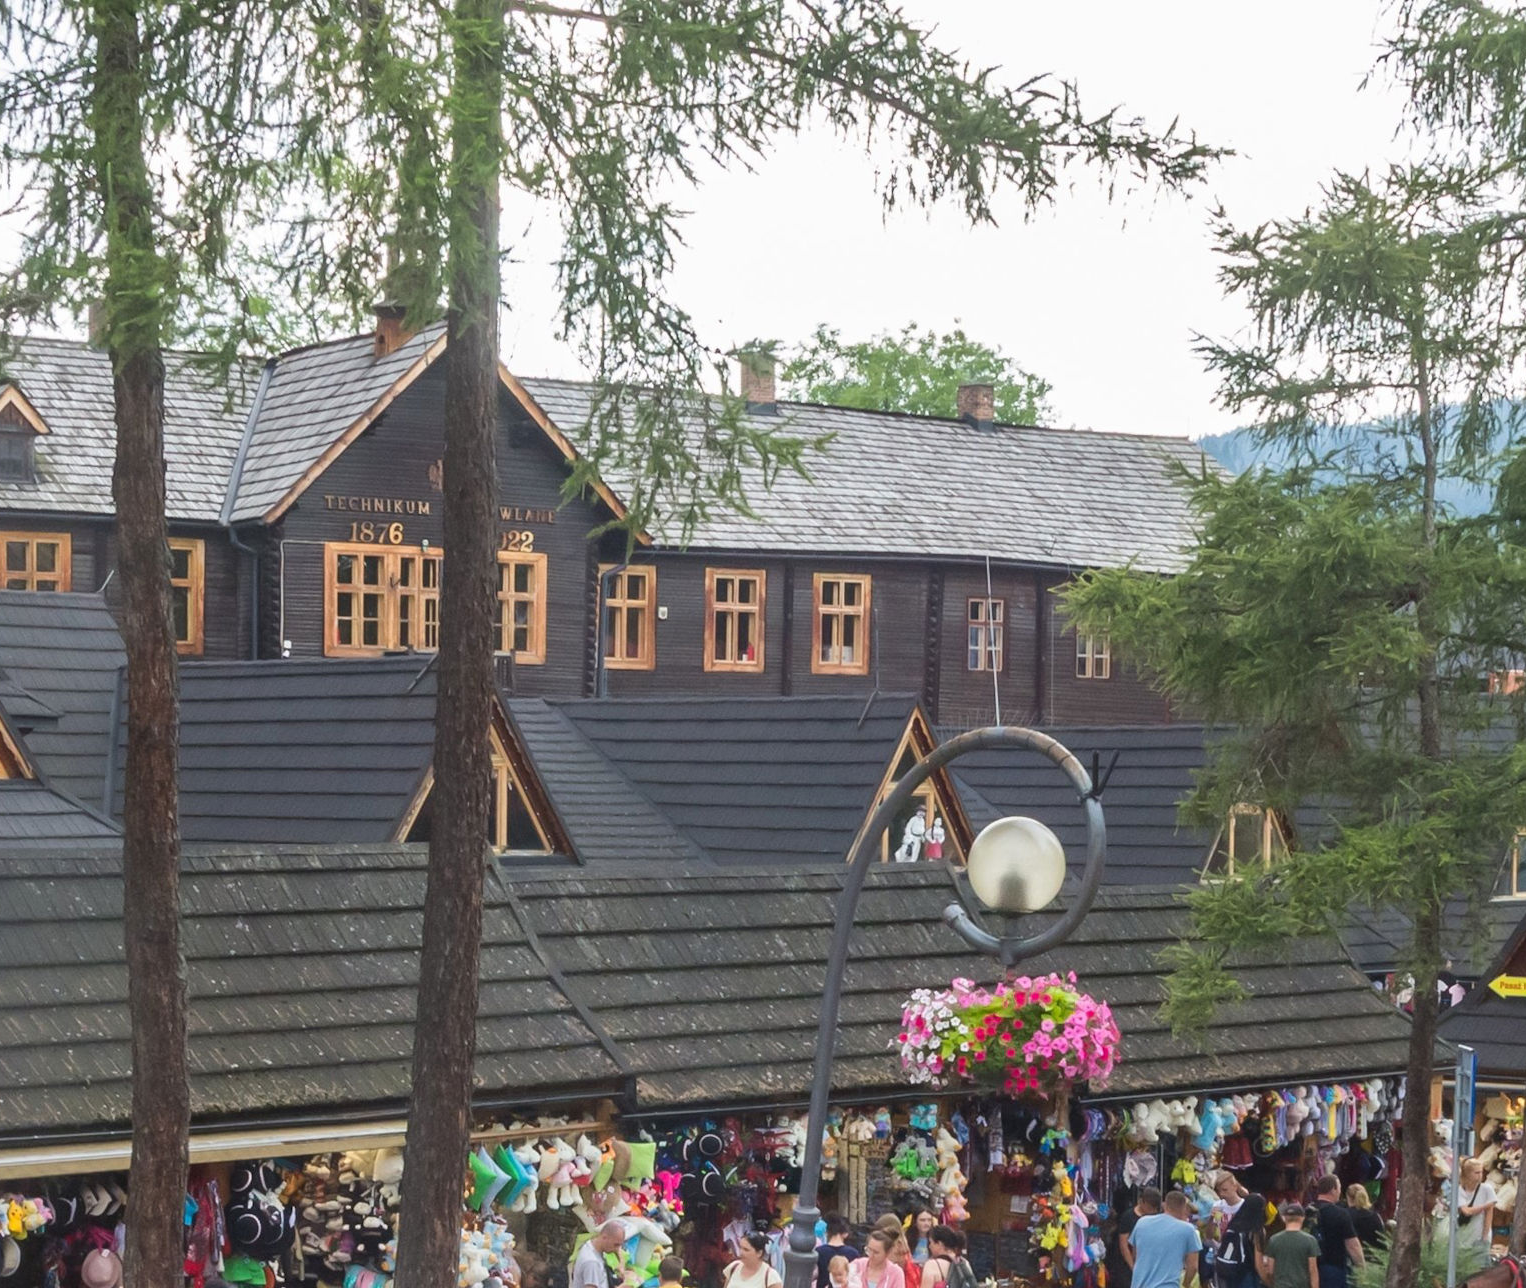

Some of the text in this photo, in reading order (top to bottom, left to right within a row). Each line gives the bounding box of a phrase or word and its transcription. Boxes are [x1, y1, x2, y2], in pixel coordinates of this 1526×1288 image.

[324, 495, 556, 524] TECHNIKUM WLANE
[349, 522, 404, 544] 1876
